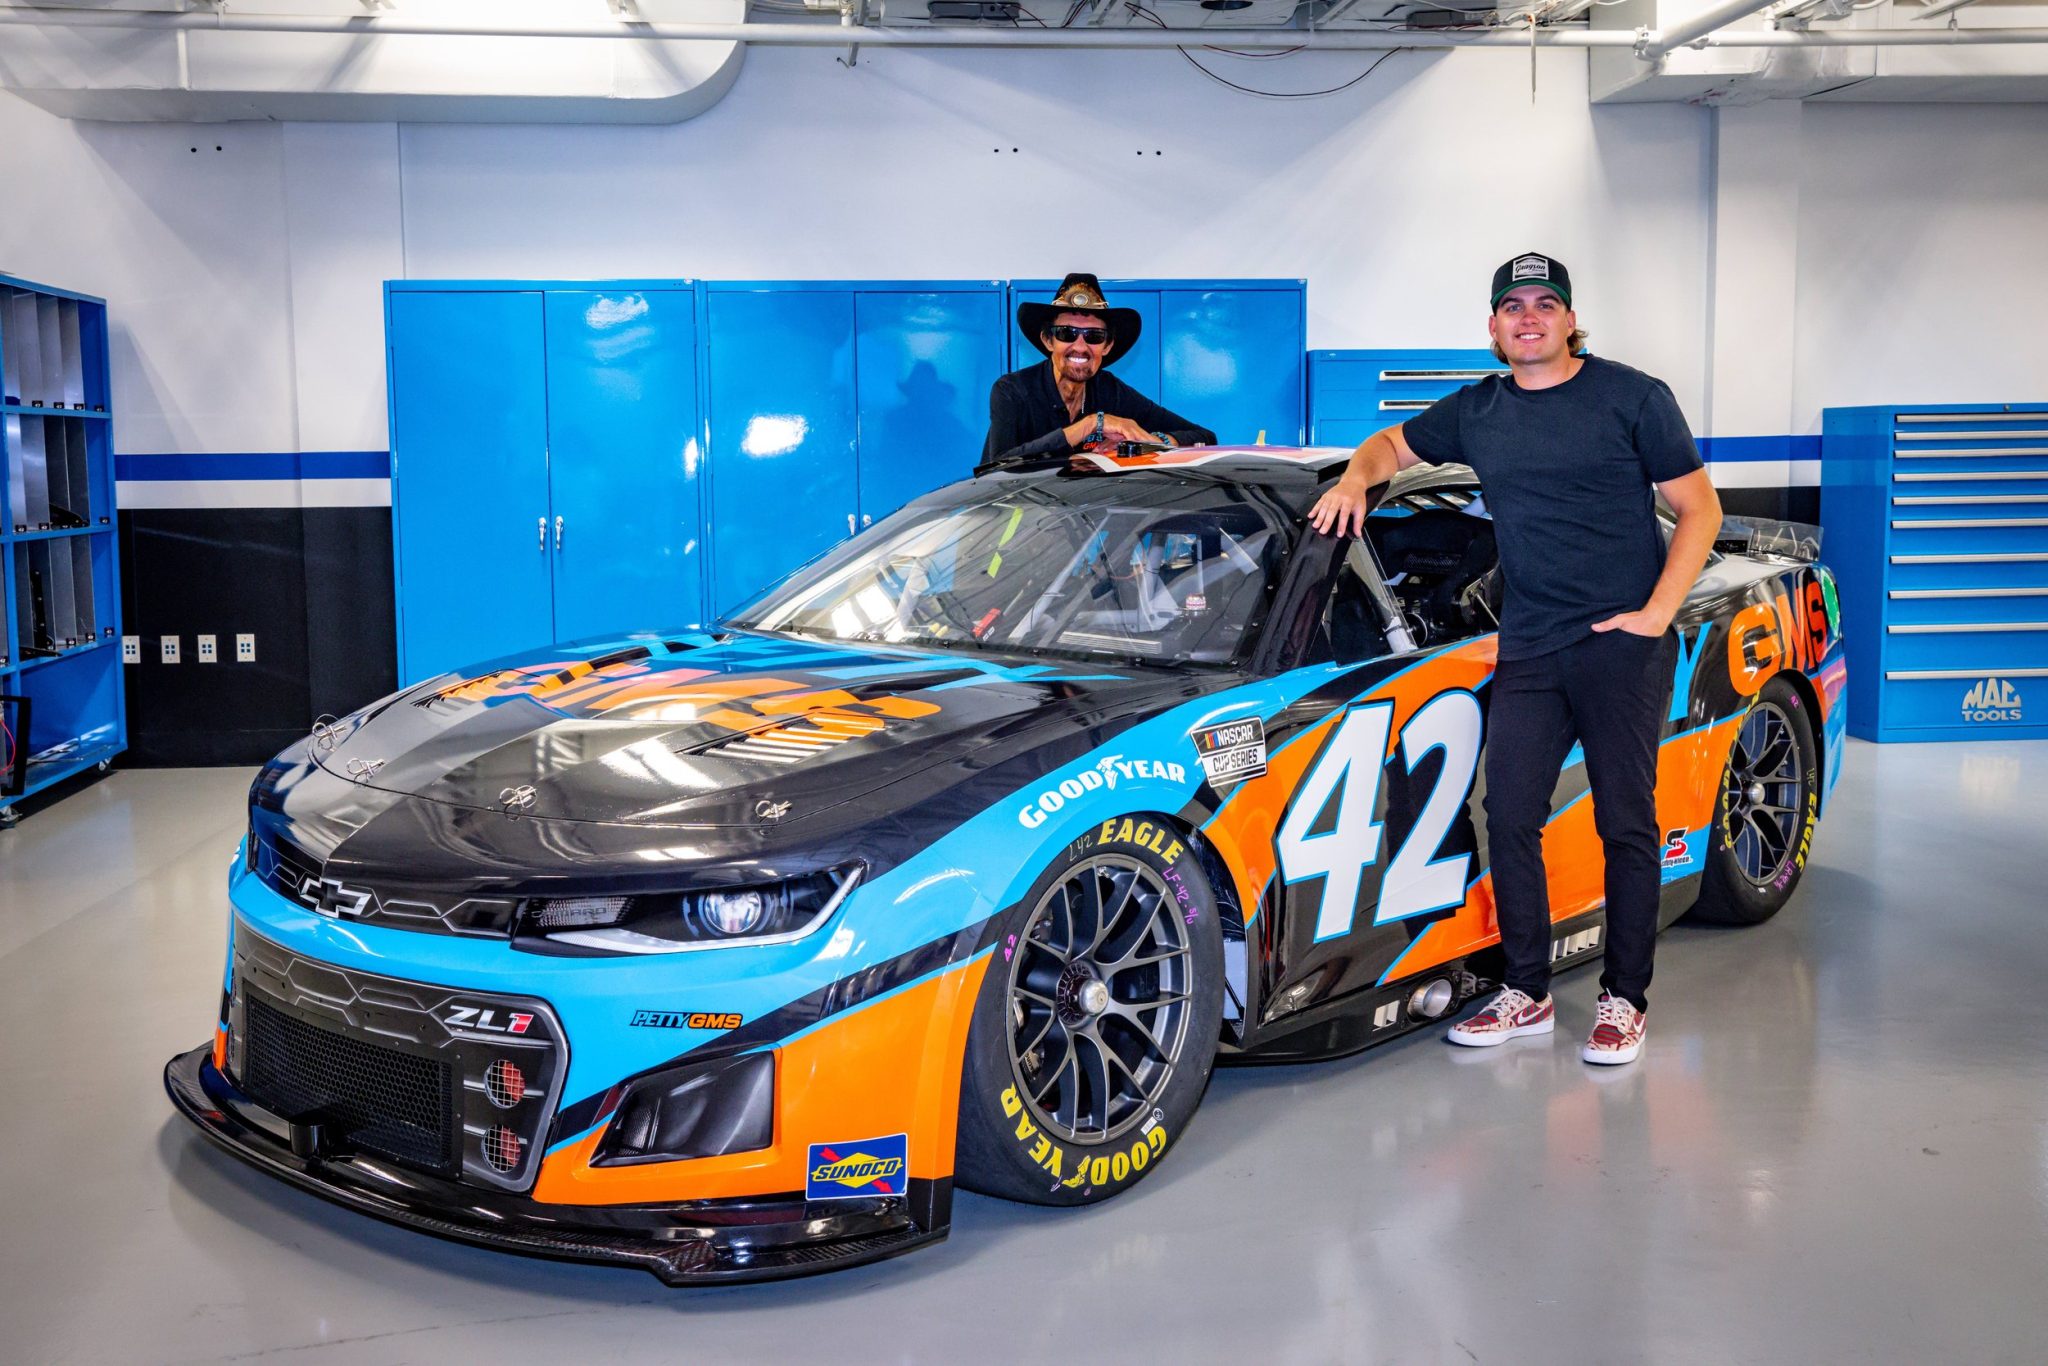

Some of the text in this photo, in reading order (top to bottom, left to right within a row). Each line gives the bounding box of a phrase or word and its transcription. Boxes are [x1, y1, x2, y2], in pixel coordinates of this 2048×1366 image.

[1961, 678, 2022, 710] MAC
[1961, 709, 2023, 722] TOOLS
[1216, 723, 1255, 748] NASCAR
[1212, 747, 1259, 773] CUP SERIES
[1018, 755, 1186, 829] GOODYEAR
[1276, 686, 1483, 944] 42
[1097, 818, 1184, 865] EAGLE
[1796, 791, 1817, 874] EAGLE
[443, 1004, 535, 1034] ZL1
[1000, 1082, 1167, 1188] GOODYEAR
[815, 1159, 900, 1180] SUNOCO
